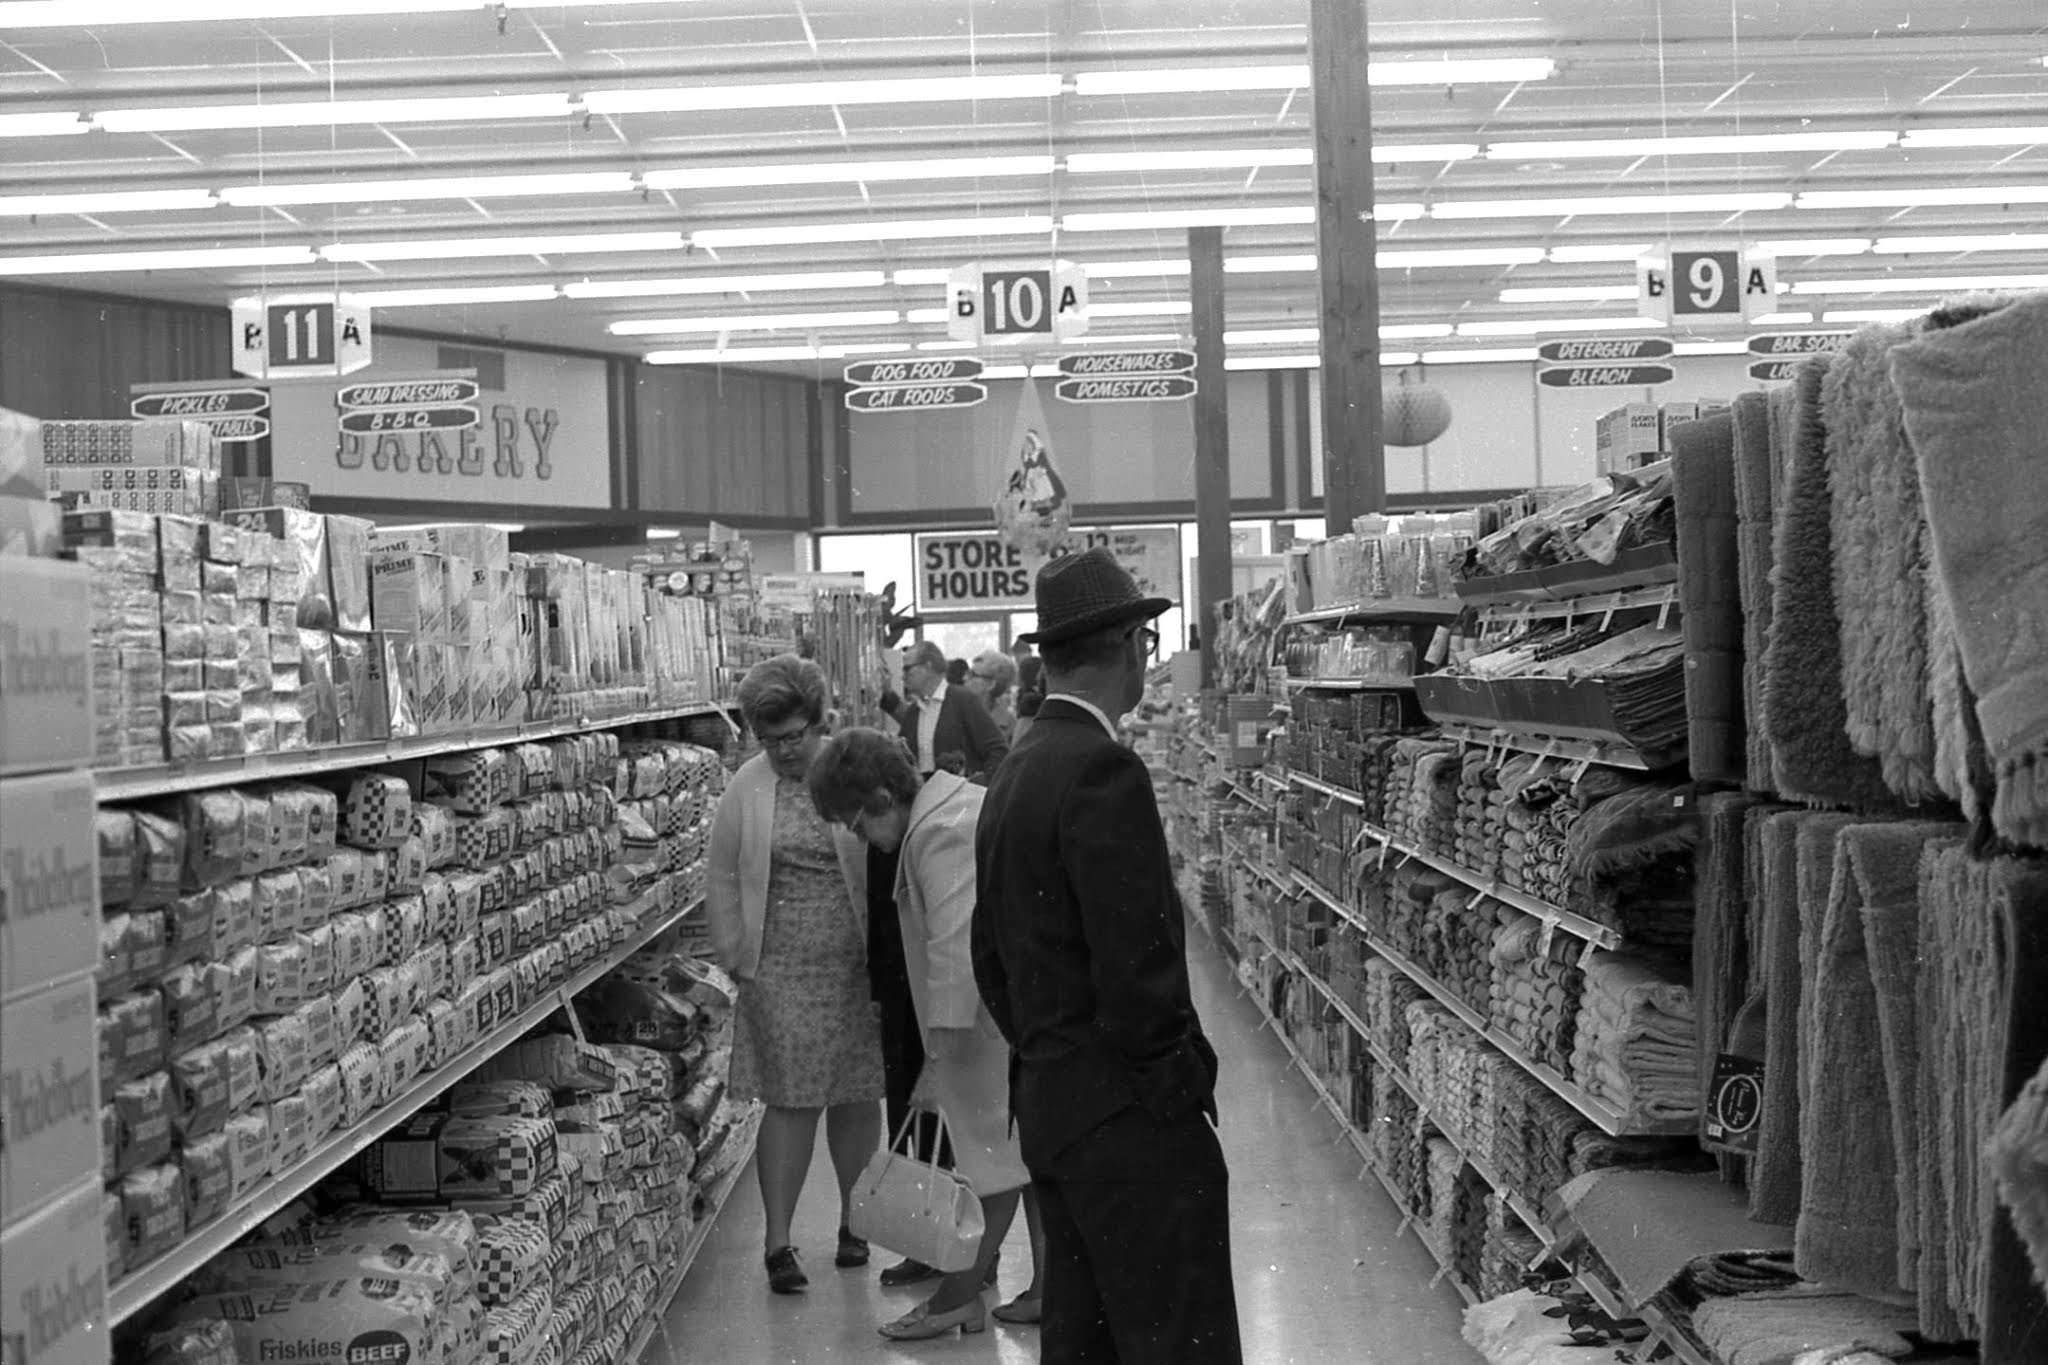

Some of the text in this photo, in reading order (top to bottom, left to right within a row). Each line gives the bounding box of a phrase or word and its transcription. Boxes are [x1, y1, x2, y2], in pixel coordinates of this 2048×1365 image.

[1689, 257, 1724, 309] 9
[1746, 267, 1767, 295] A
[991, 277, 1043, 330] 10
[1059, 285, 1077, 314] A
[283, 308, 318, 360] 11
[342, 317, 361, 345] A
[1772, 336, 1802, 353] BAR
[1557, 341, 1644, 359] DETERGENT
[871, 360, 955, 381] DOG FOOD
[1073, 353, 1174, 372] HOUSEWARES
[1568, 369, 1632, 385] BLEACH
[352, 382, 460, 404] SALAD DRESSING
[868, 387, 955, 407] CAT FOODS
[1076, 381, 1170, 398] DOMESTICS
[160, 394, 229, 414] PICKLES
[925, 539, 1022, 571] STORE
[927, 570, 1030, 600] HOURS
[259, 1337, 406, 1363] Friskies BEEF
